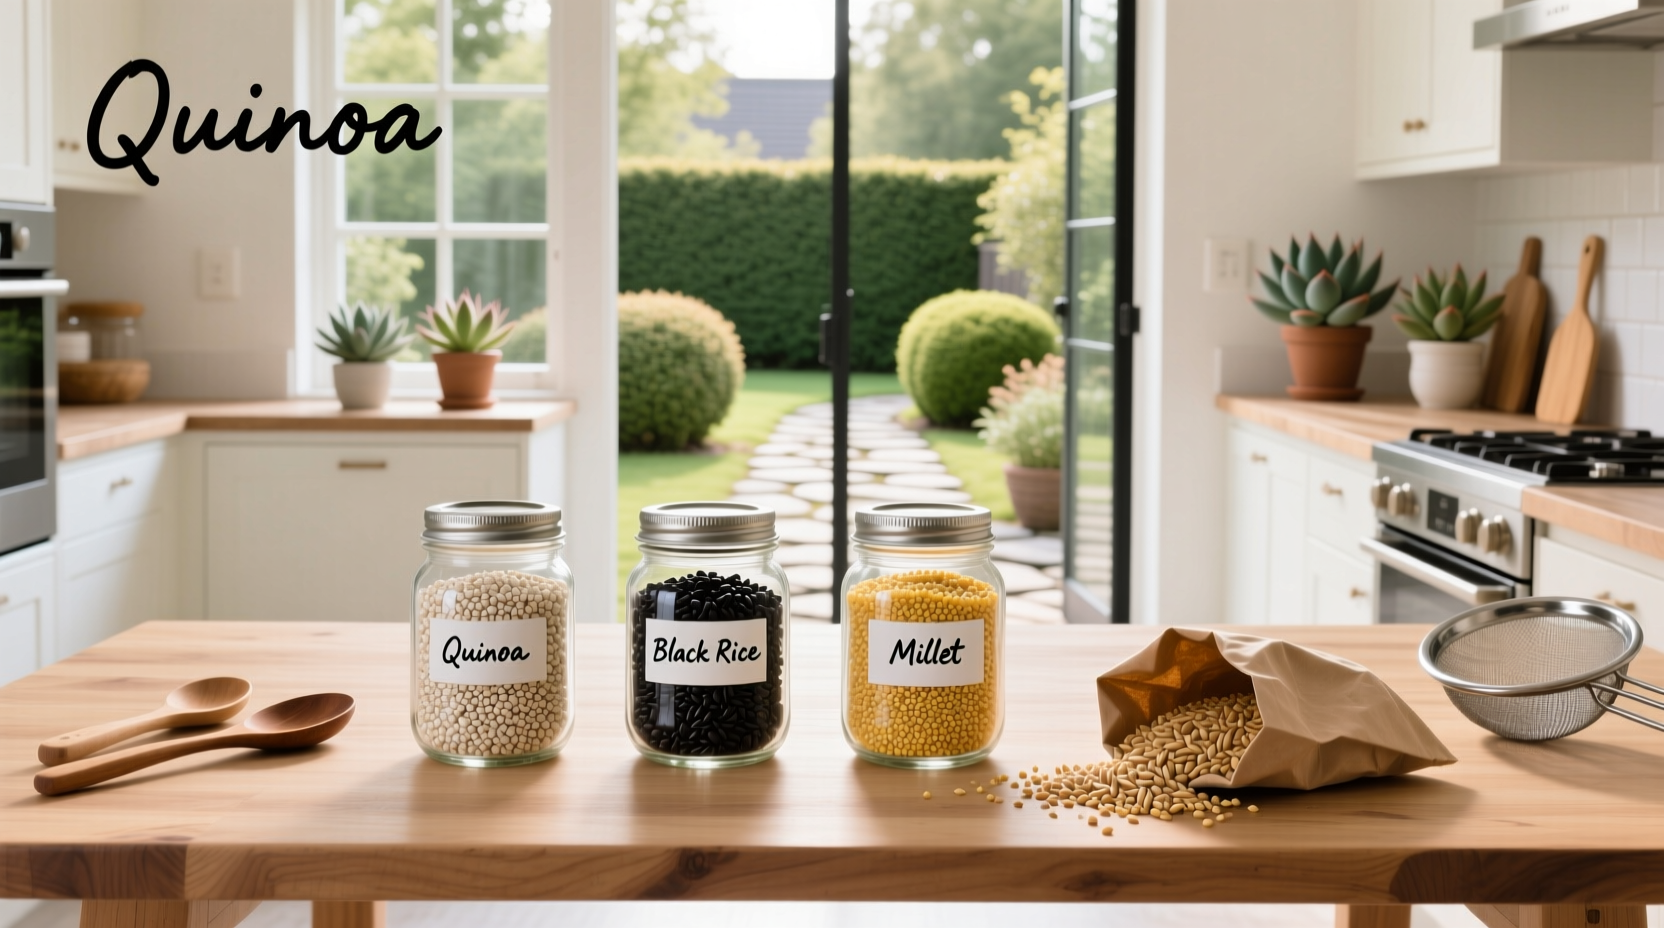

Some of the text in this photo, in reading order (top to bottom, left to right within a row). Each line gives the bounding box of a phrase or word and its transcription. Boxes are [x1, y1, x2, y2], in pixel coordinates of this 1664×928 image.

[442, 635, 531, 669] Quinoa
[653, 636, 762, 664] Black Rice
[888, 637, 966, 667] Millet
